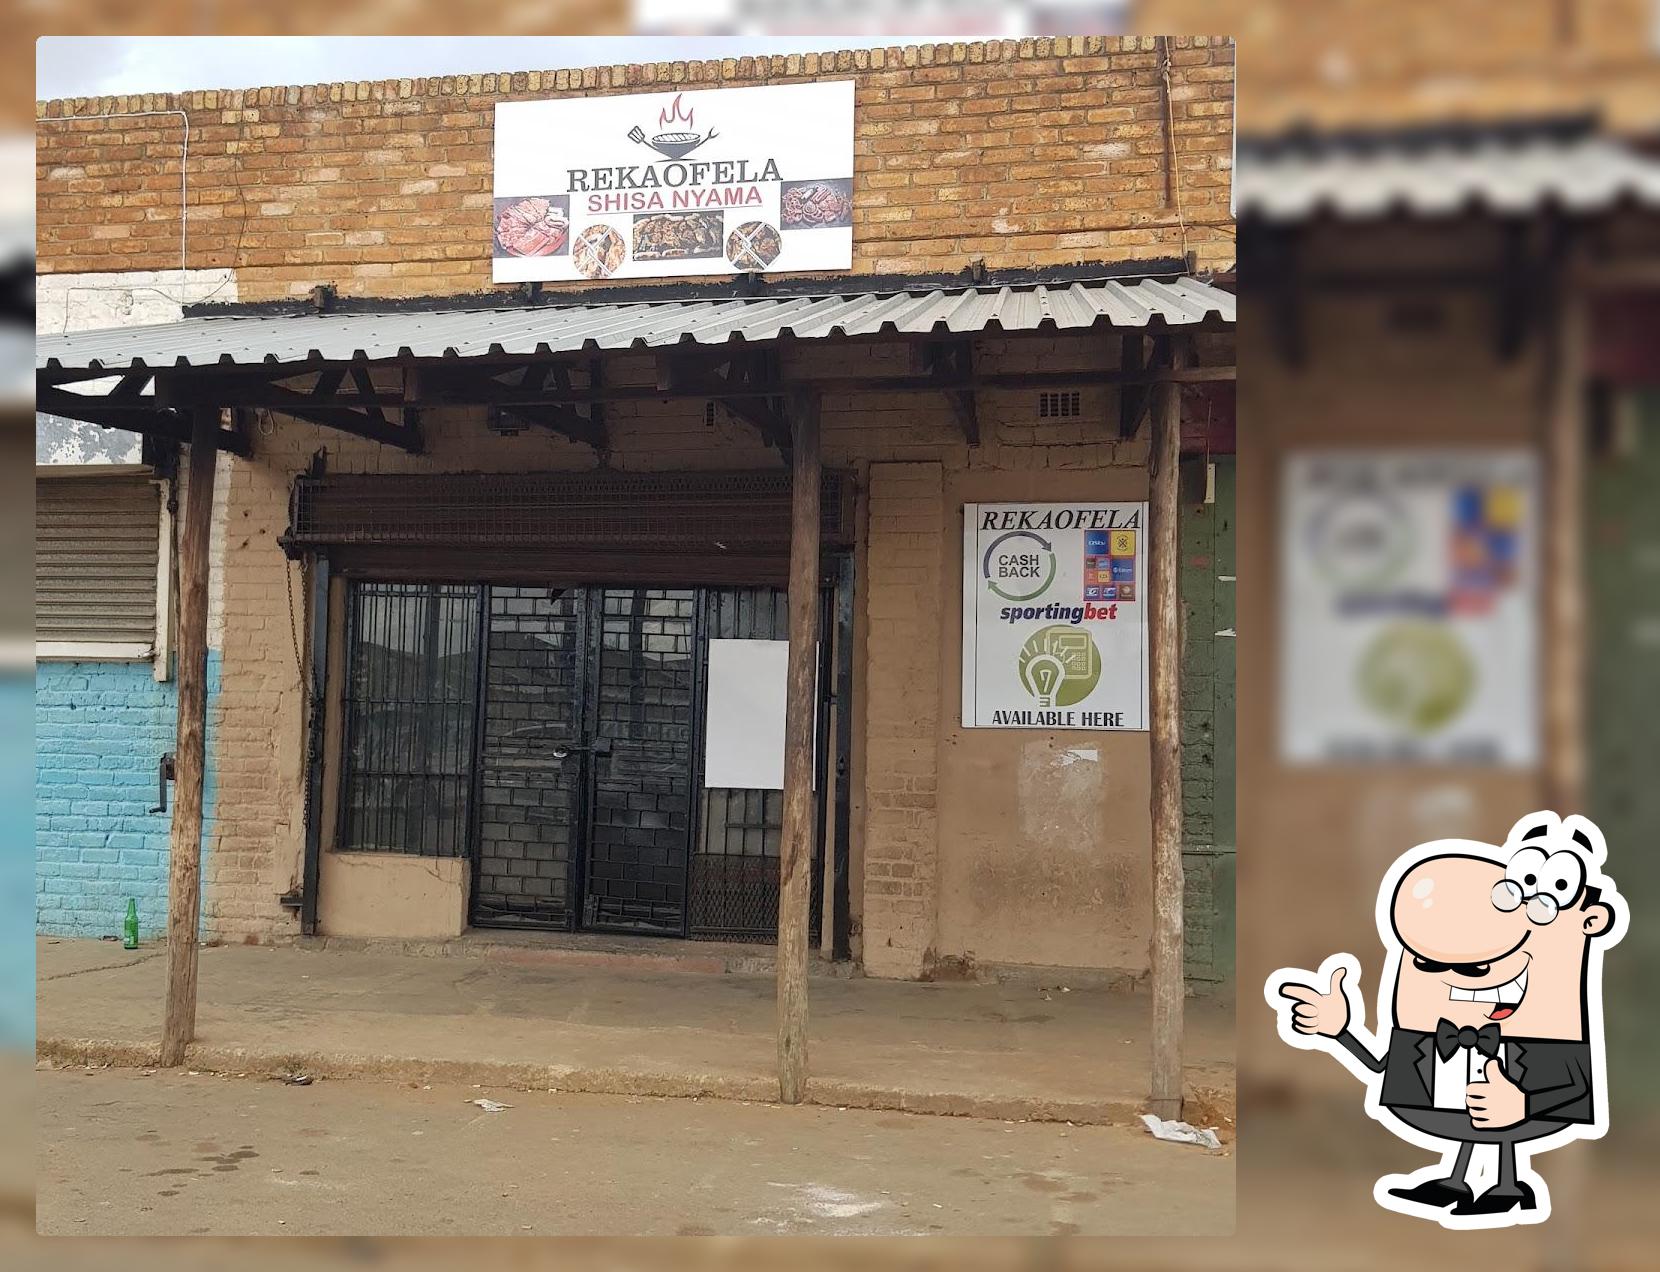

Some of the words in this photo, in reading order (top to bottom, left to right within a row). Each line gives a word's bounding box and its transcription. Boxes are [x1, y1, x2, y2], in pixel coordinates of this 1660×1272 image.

[567, 158, 783, 192] REKAOFELA
[588, 191, 664, 212] SHISA
[672, 186, 763, 208] NYAMA
[981, 510, 1141, 530] REKAOFELA
[998, 555, 1040, 567] CASH
[998, 566, 1040, 578] BACK
[1000, 603, 1117, 624] sportingbet
[992, 711, 1075, 726] AVAILABLE
[1082, 712, 1124, 727] HERE
